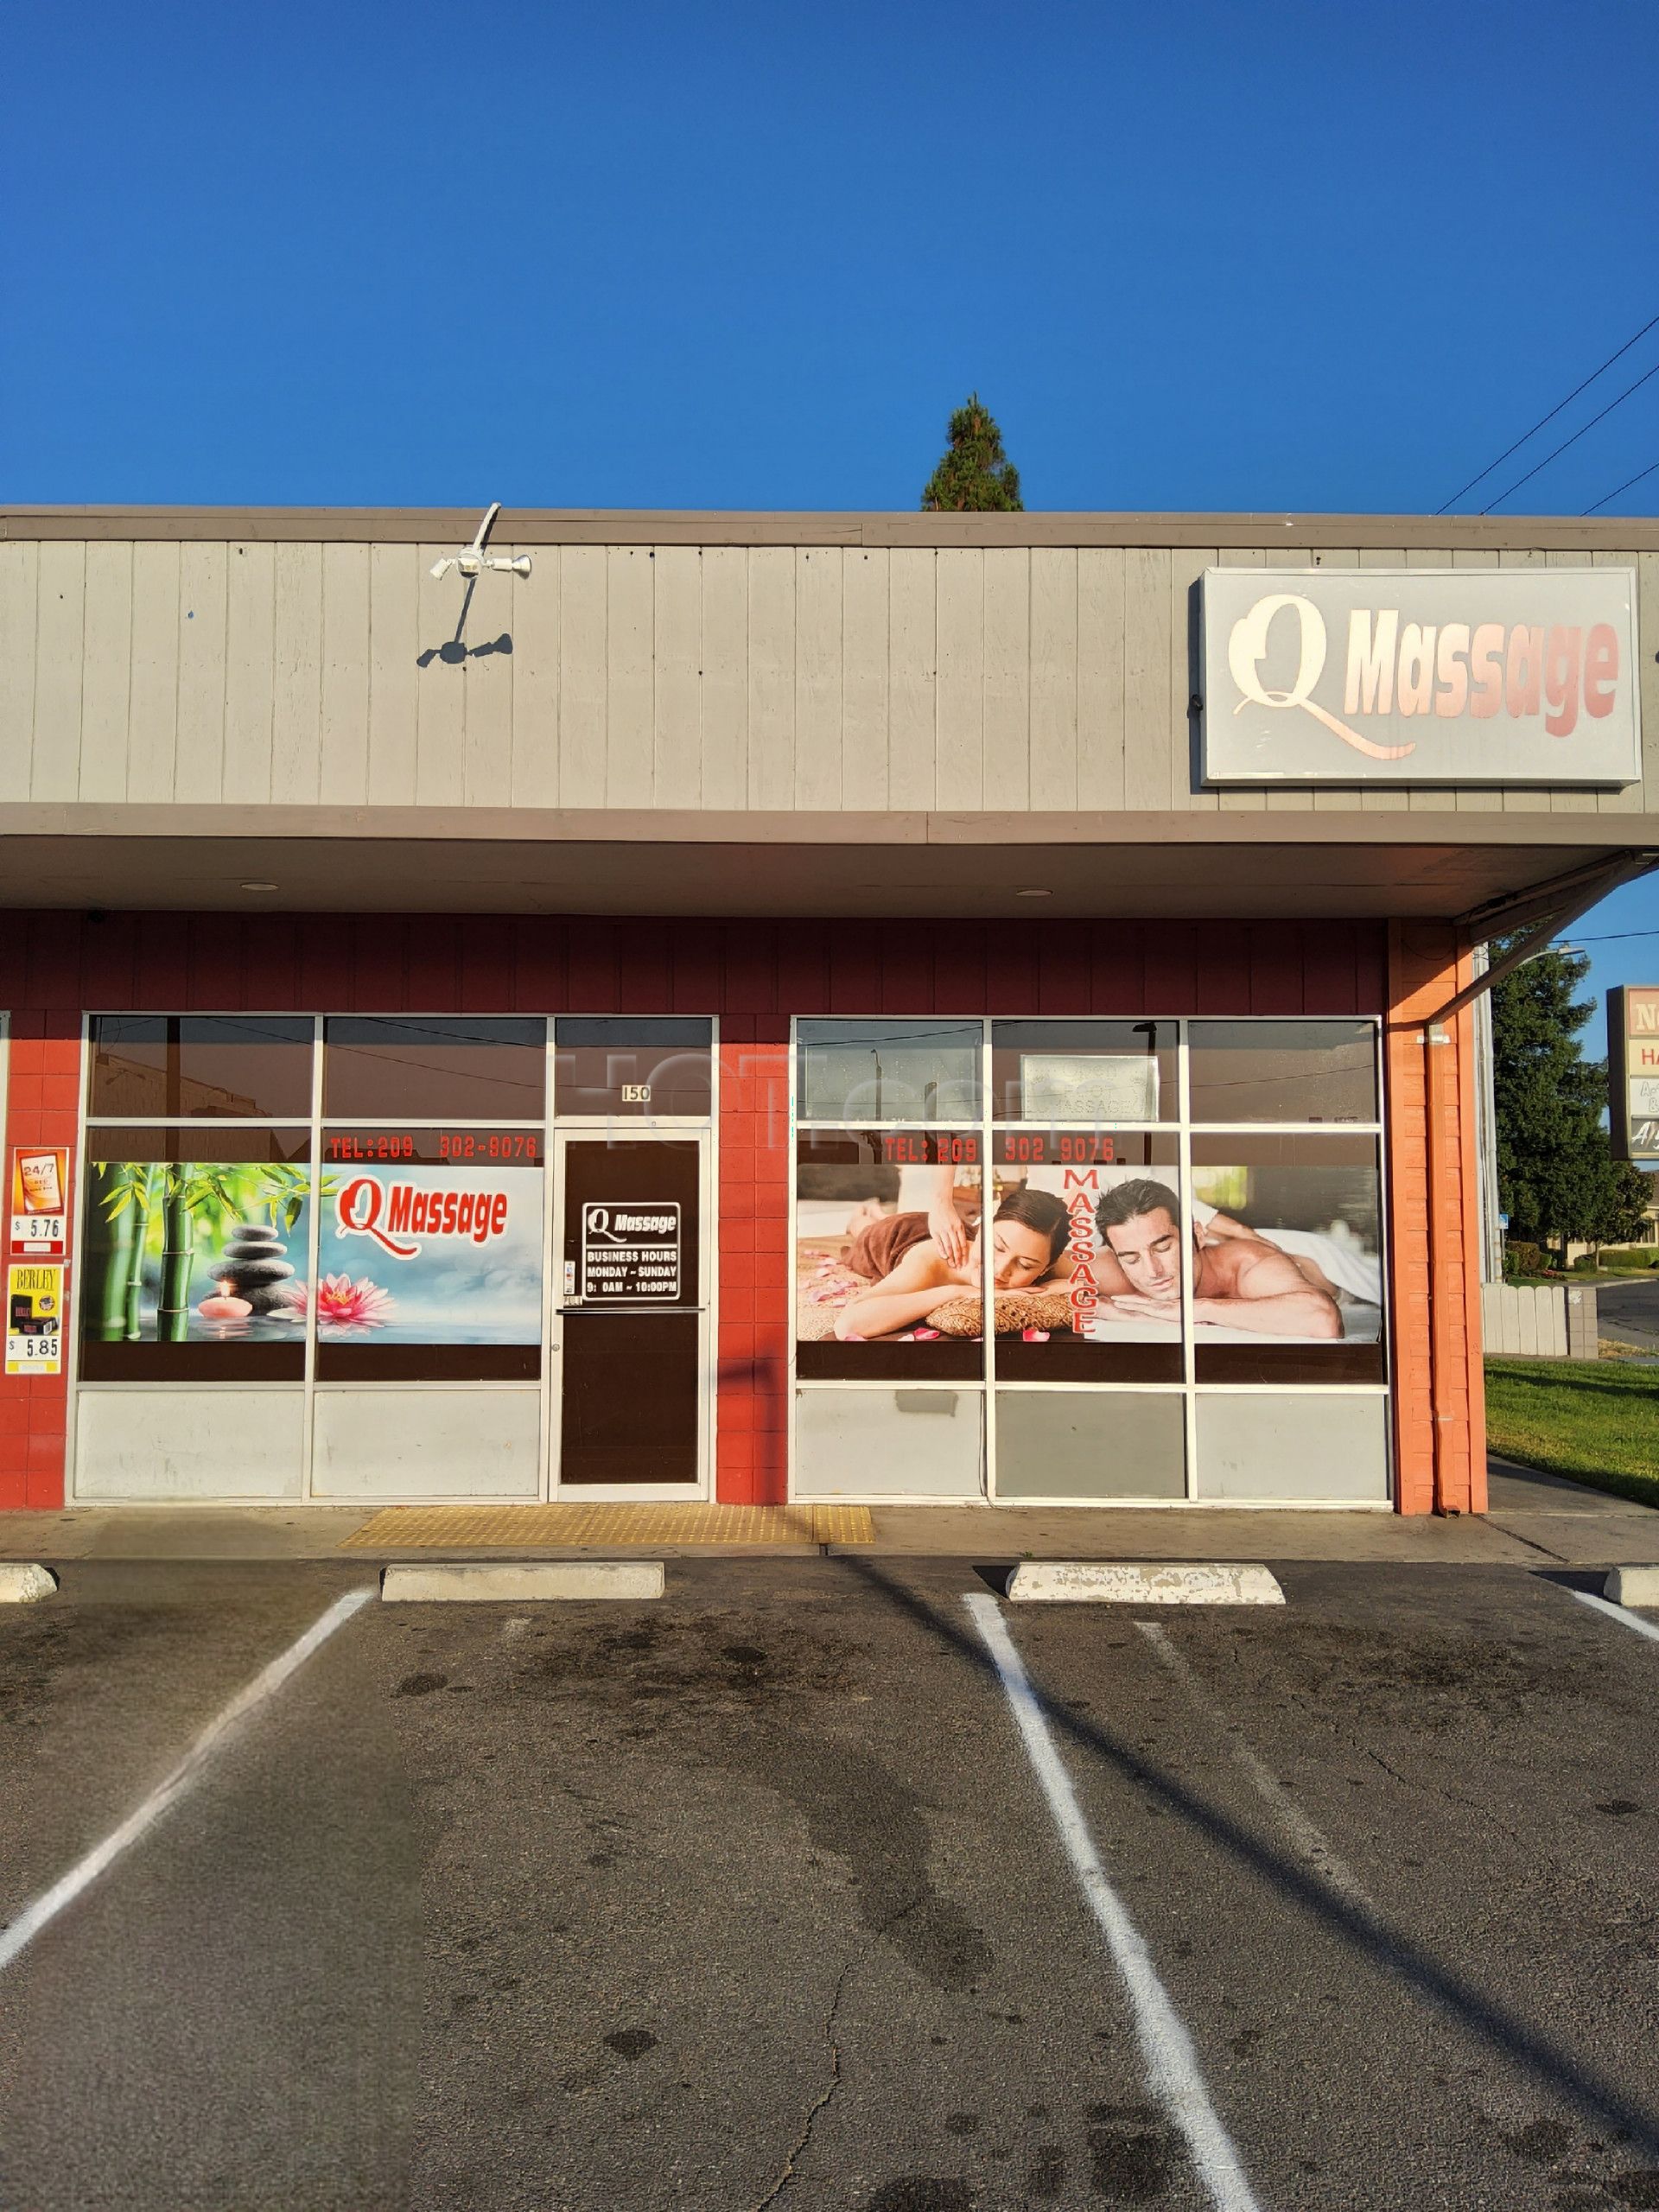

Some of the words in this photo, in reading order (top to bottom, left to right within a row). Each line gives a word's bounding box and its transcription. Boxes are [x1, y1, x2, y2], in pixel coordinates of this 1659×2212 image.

[1228, 594, 1415, 760] Q
[1344, 608, 1618, 737] Massage
[1636, 1004, 1659, 1030] N
[624, 1086, 650, 1100] 150
[439, 1136, 537, 1158] 302-9076
[885, 1137, 928, 1161] TEL:
[938, 1137, 977, 1161] 209
[1005, 1137, 1044, 1161] 302
[1060, 1137, 1114, 1161] 9076
[24, 1163, 54, 1176] 24/7
[340, 1179, 417, 1255] Q
[388, 1186, 507, 1243] Massage
[588, 1209, 627, 1243] Q
[614, 1214, 677, 1234] Massage
[31, 1219, 59, 1237] 5.76
[588, 1251, 639, 1262] BUSINESS
[641, 1251, 677, 1262] HOURS
[1064, 1169, 1099, 1333] MASSAGE
[17, 1269, 54, 1290] BERLEY
[588, 1267, 627, 1277] MONDAY
[639, 1267, 677, 1277] SUNDAY
[636, 1282, 677, 1292] 10:00PM
[28, 1338, 57, 1357] 5.85
